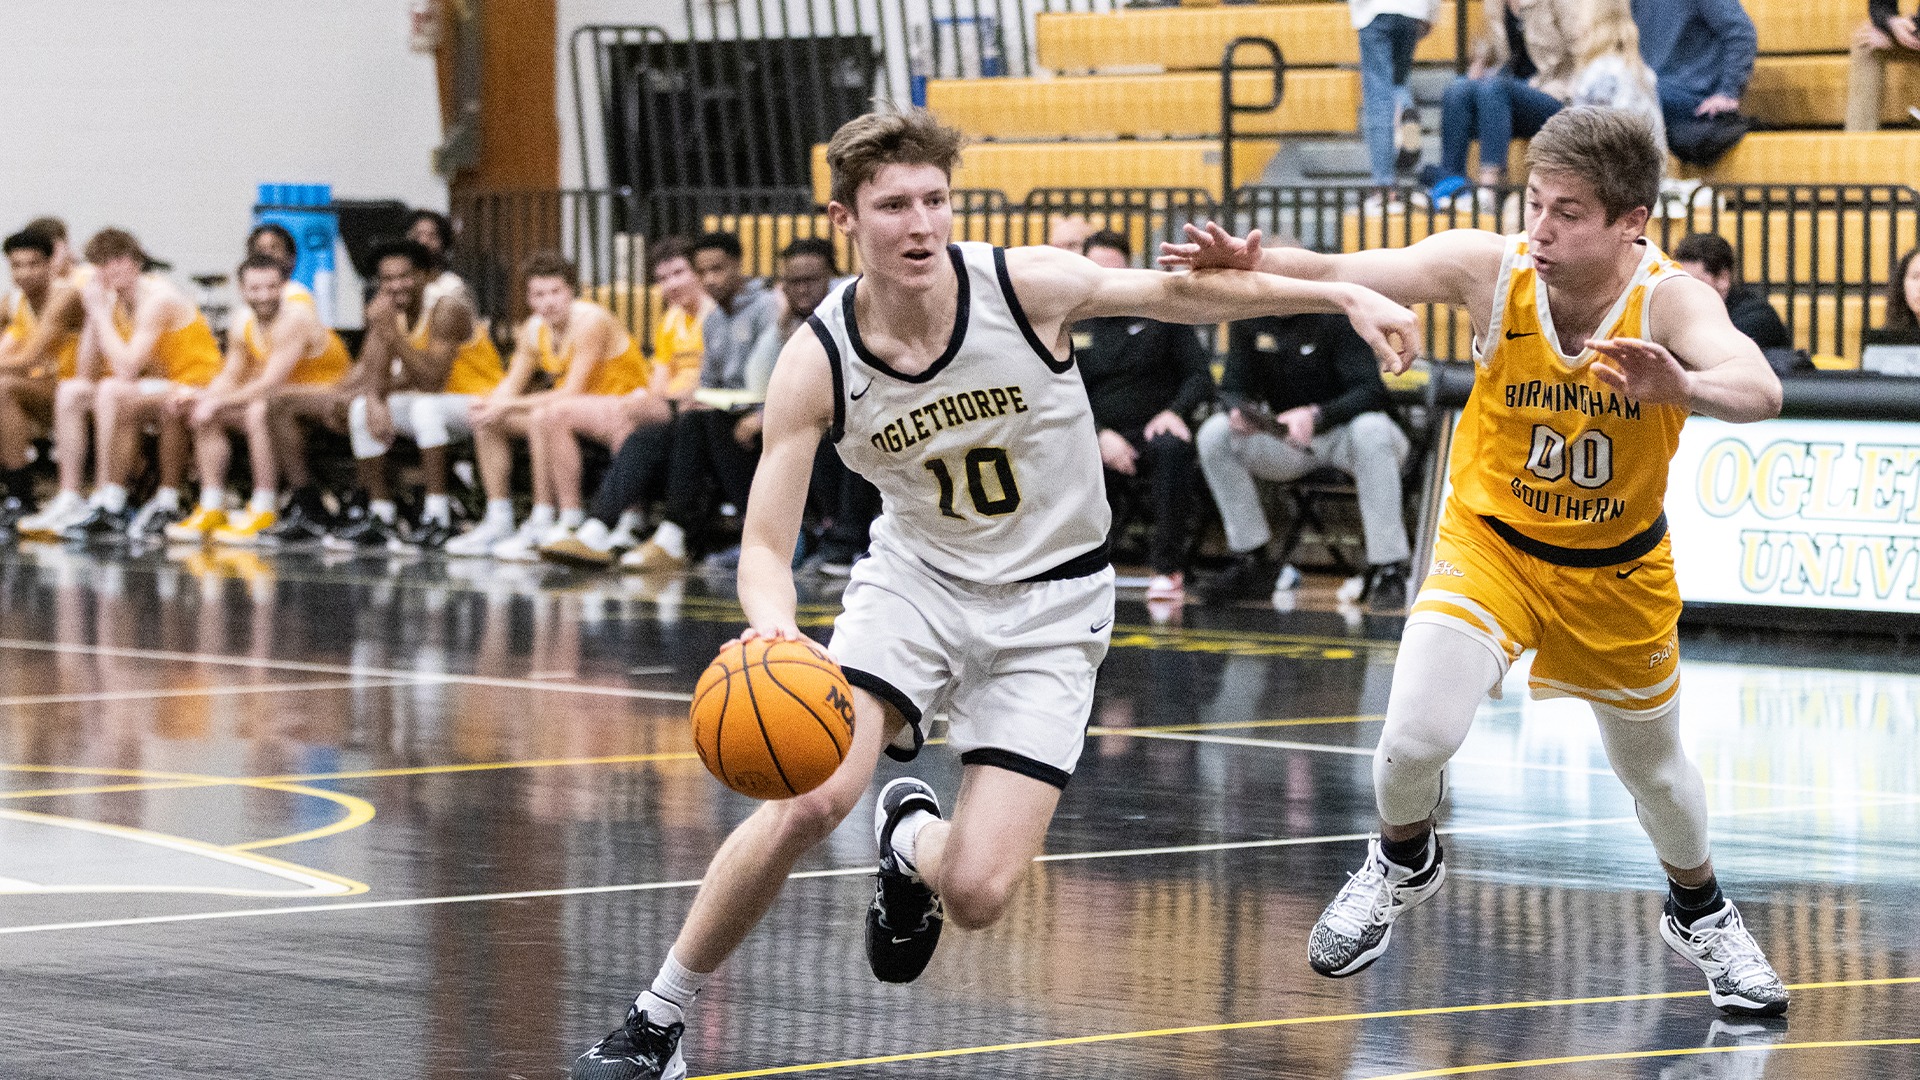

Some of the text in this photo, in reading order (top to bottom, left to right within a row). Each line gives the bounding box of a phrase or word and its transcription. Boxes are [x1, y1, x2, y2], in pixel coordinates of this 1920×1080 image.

[871, 386, 1029, 453] OGLETHORPE
[1505, 379, 1641, 420] BIRMINGHAM
[923, 447, 1021, 520] 10
[1524, 423, 1613, 489] 00
[1510, 477, 1625, 523] SOUTHERN
[1739, 528, 1920, 600] UNIV
